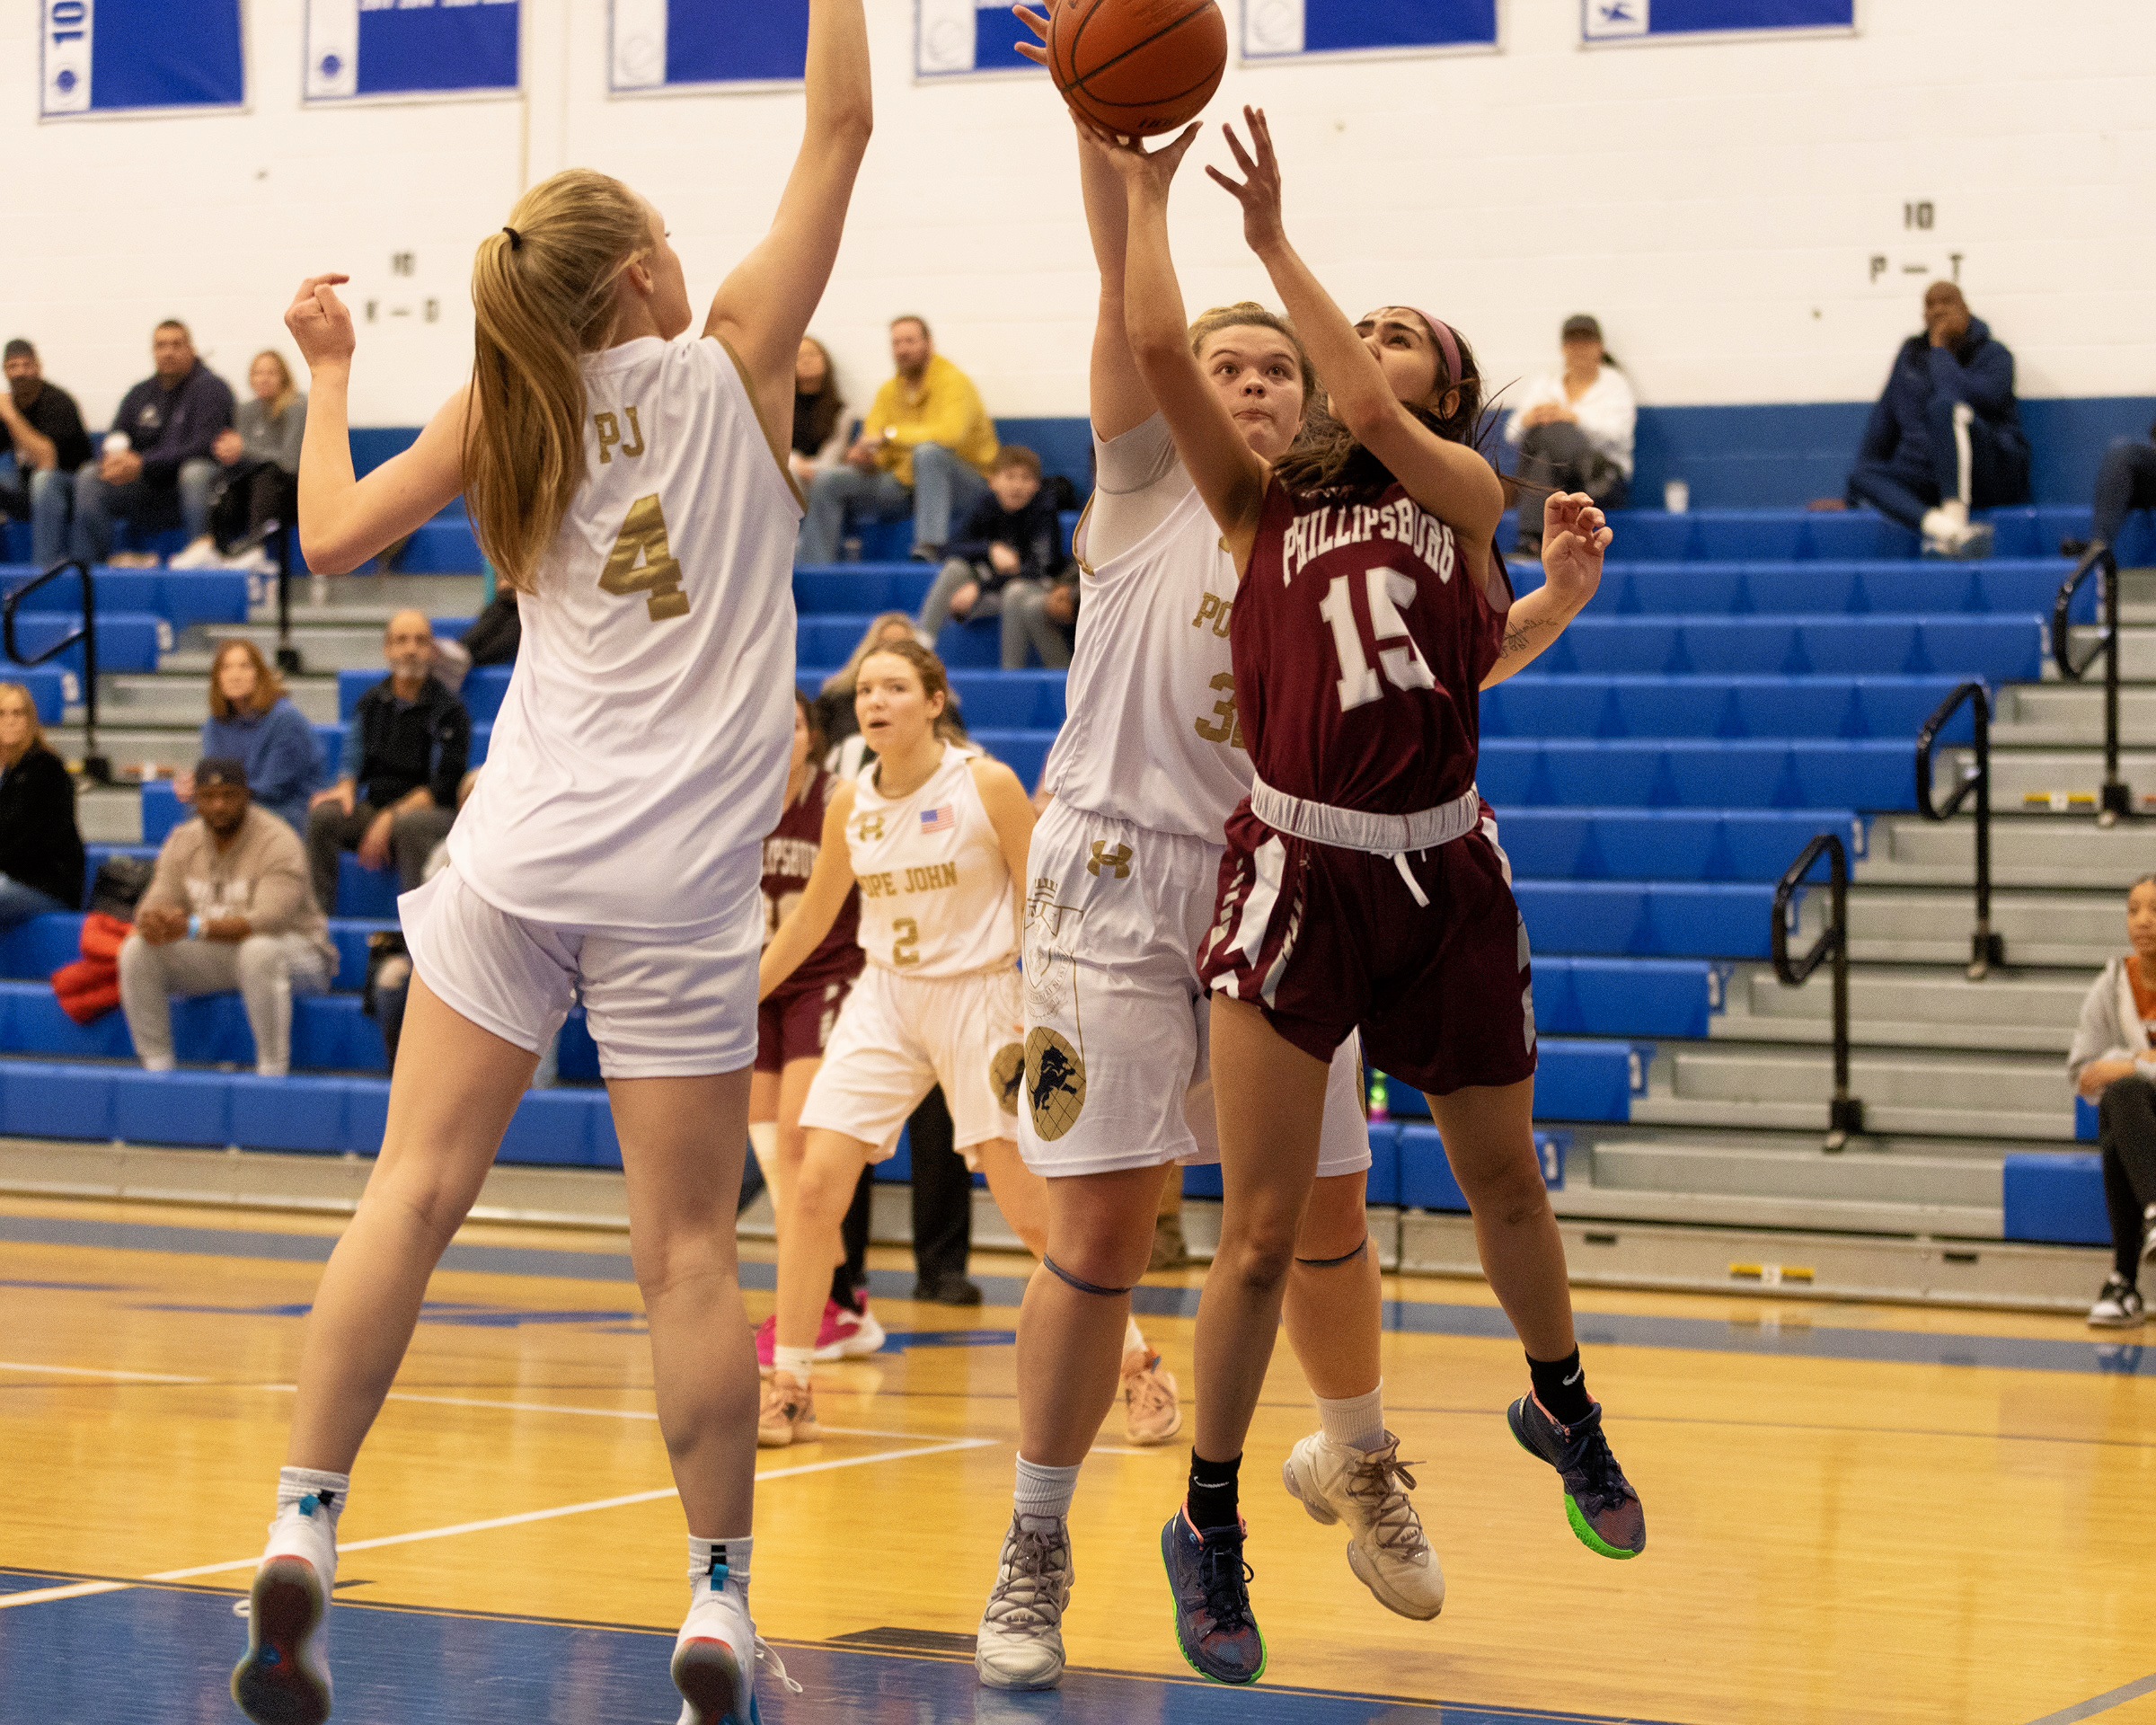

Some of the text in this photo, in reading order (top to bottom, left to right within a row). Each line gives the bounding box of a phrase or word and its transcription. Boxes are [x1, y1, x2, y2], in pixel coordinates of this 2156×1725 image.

[51, 1, 85, 47] 10
[1904, 200, 1934, 230] 10
[594, 406, 645, 464] PJ
[597, 492, 691, 622] 4
[1283, 497, 1455, 588] PHILLIPSBURG
[1319, 566, 1436, 712] 15
[857, 861, 959, 898] OPE JOHN
[892, 917, 920, 967] 2
